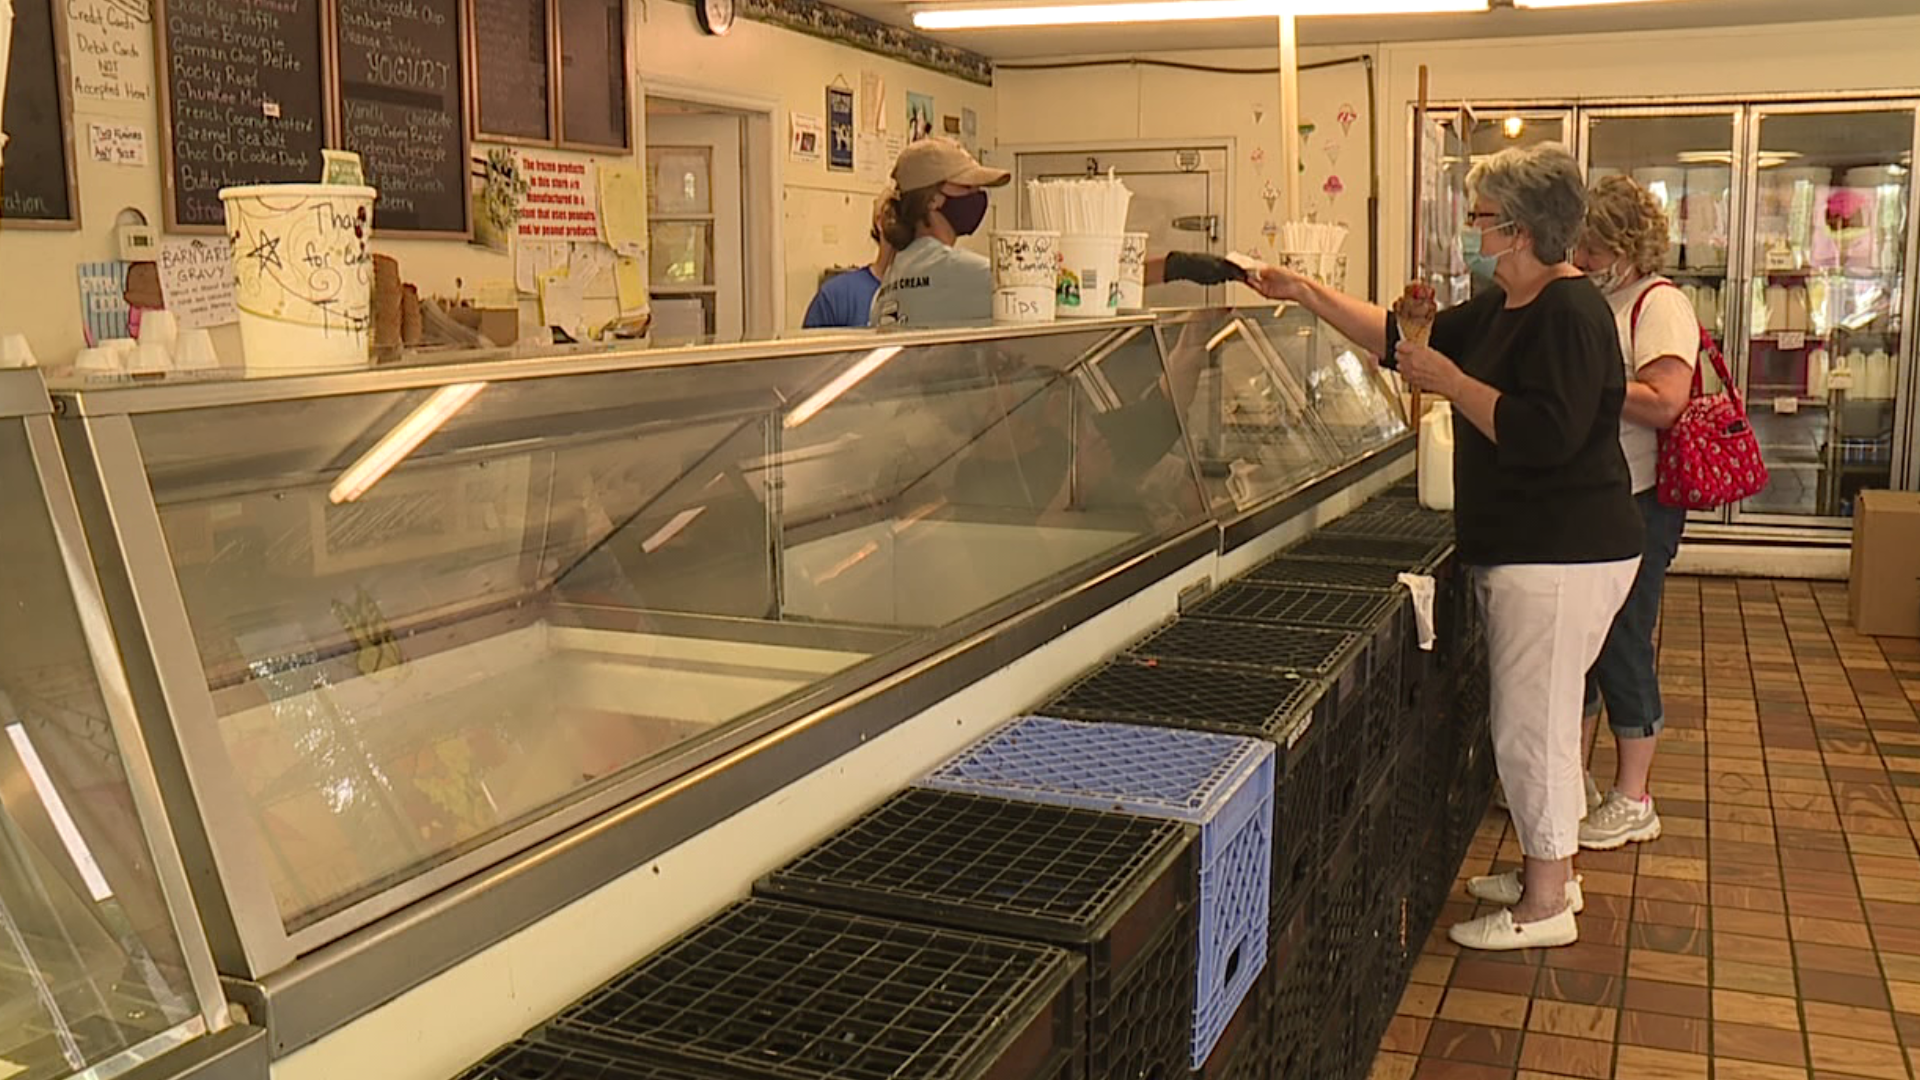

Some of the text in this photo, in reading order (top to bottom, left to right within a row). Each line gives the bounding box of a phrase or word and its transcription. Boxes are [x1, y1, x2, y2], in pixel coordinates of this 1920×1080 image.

[252, 0, 298, 13] lmond
[238, 8, 279, 33] Truffle
[169, 16, 285, 52] Charlie Brownie
[173, 37, 301, 72] German Choc Delite
[98, 60, 118, 72] NOT
[173, 55, 259, 90] Rocky Road
[366, 52, 450, 90] YOGURT
[176, 100, 223, 122] French
[225, 107, 269, 129] Coconut
[344, 100, 384, 121] Vanilla
[176, 121, 287, 149] Caramel Sea Salt
[345, 117, 380, 138] Lemon
[176, 140, 209, 160] Choc
[212, 143, 238, 168] Chip
[240, 148, 279, 165] Cookie
[181, 164, 219, 191] Butter
[522, 158, 585, 175] The frozen products
[538, 176, 550, 188] this
[551, 178, 568, 189] store
[4, 190, 46, 214] ation
[376, 193, 415, 214] berry
[526, 192, 572, 205] manufactured
[537, 208, 550, 219] that
[552, 210, 567, 221] uses
[541, 226, 565, 237] peanut
[302, 241, 331, 268] for
[177, 266, 226, 284] GRAVY
[899, 276, 930, 290] CREAM
[1001, 291, 1039, 319] Tips
